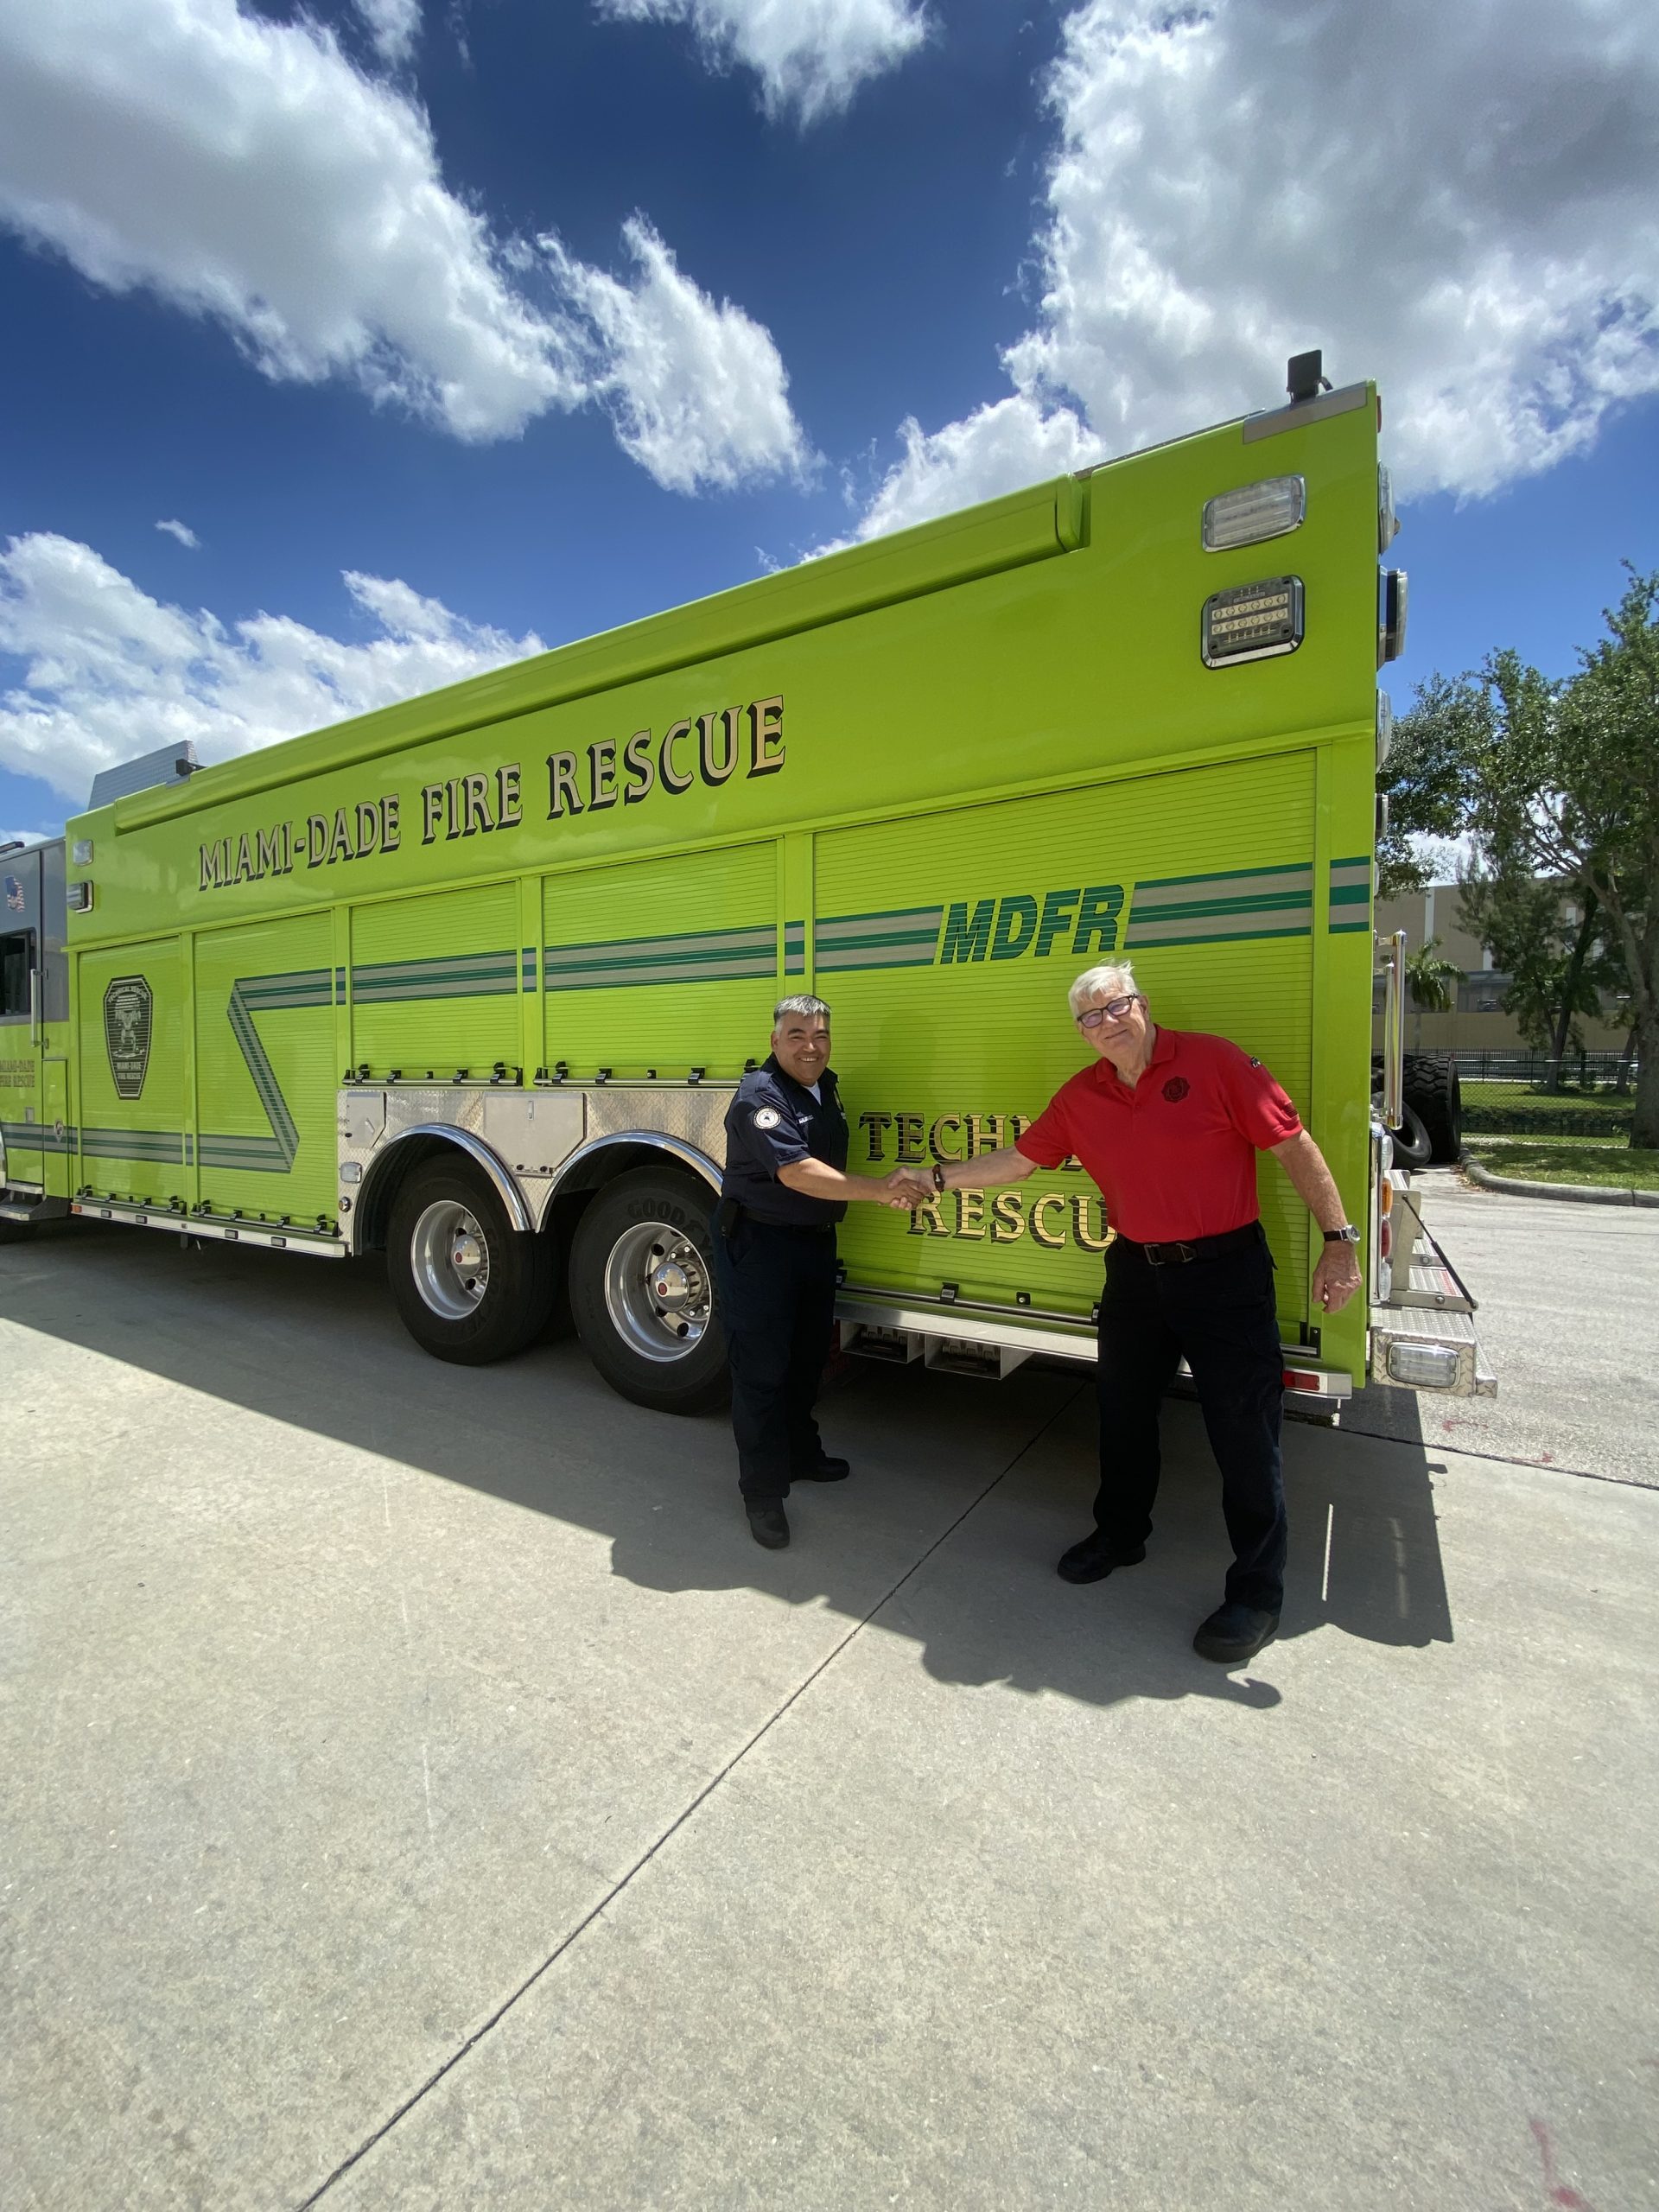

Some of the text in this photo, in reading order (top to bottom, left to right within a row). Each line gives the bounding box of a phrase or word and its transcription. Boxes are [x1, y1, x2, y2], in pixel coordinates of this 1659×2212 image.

[199, 694, 786, 891] MIAMI-DADE FIRE RESCUE
[940, 884, 1124, 964] MDFR
[858, 1111, 1084, 1172] TECH
[906, 1186, 1118, 1253] RESCU
